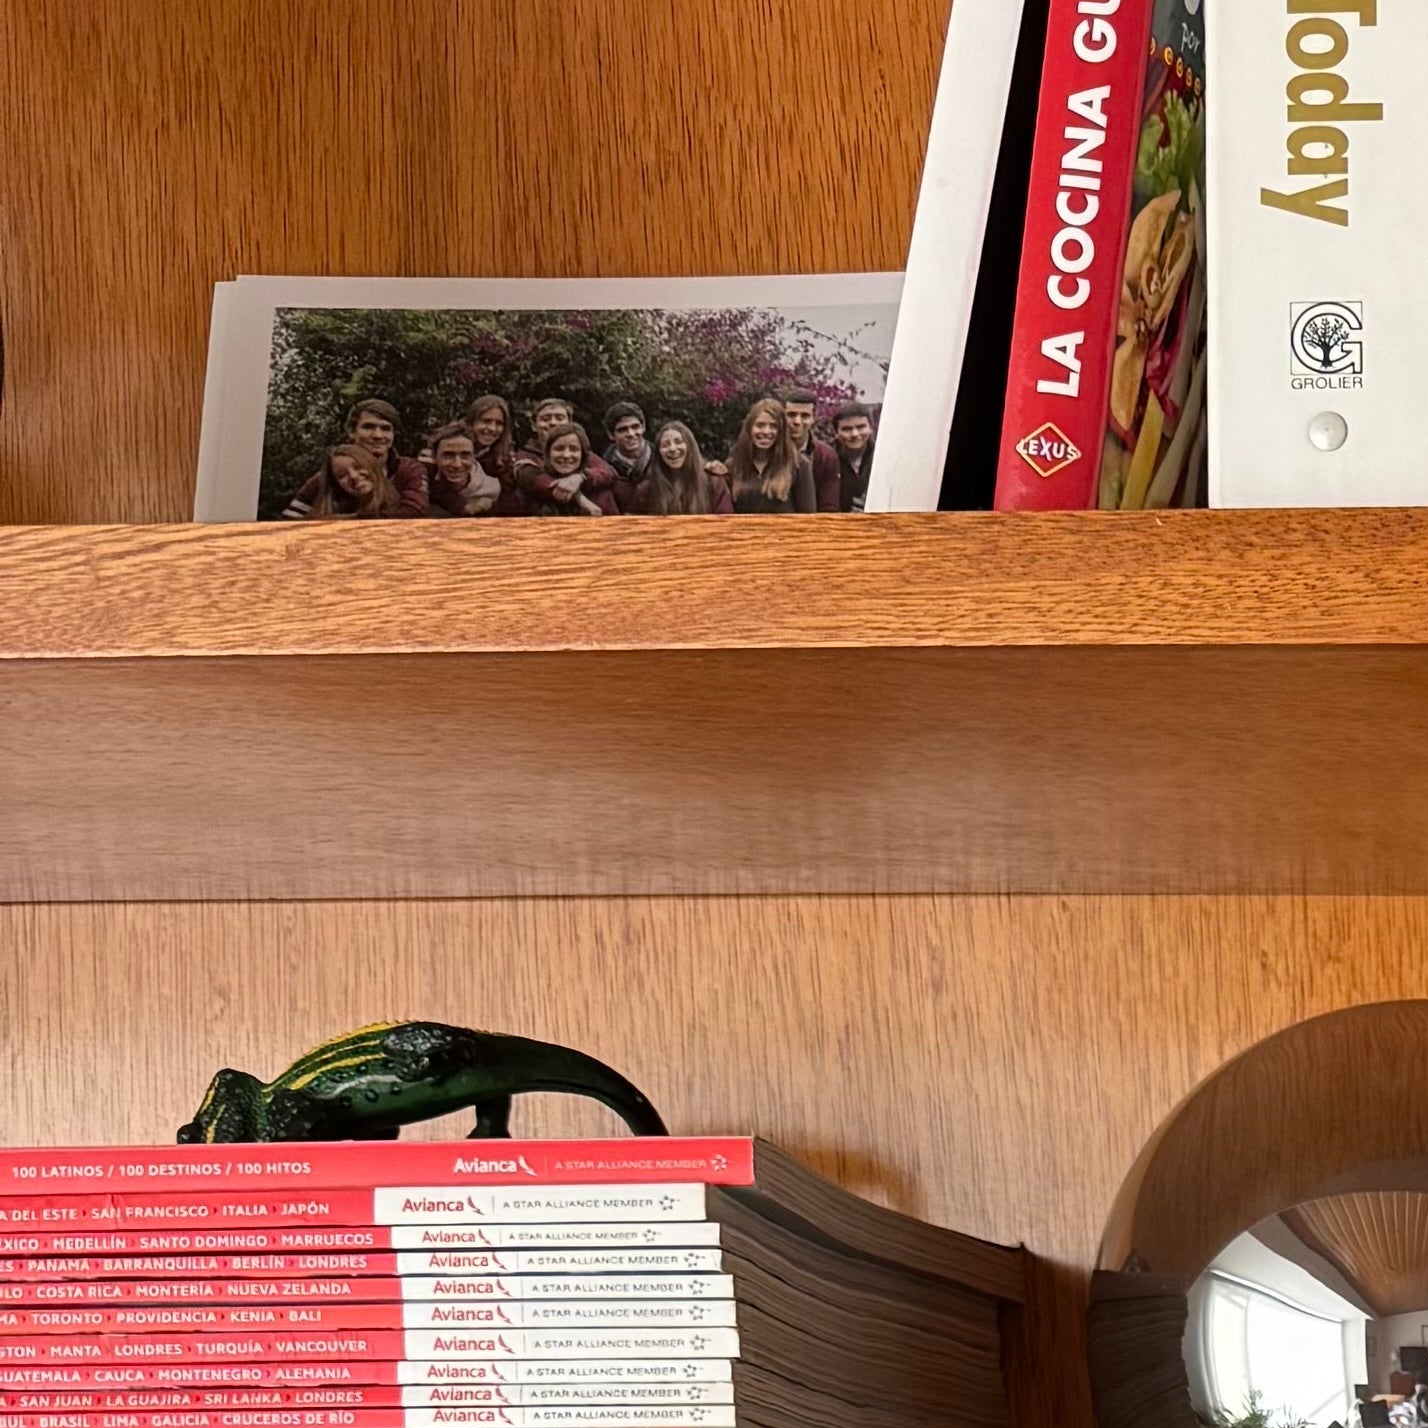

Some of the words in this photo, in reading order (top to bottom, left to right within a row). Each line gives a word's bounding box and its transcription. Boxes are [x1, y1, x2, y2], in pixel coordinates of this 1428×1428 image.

[1048, 84, 1111, 309] COCINA
[1037, 331, 1084, 397] LA
[1291, 376, 1365, 390] GROLIER
[1017, 438, 1081, 462] LEXUS
[11, 1165, 38, 1180] 100
[41, 1164, 104, 1179] LATINOS
[119, 1164, 145, 1178] 100
[148, 1163, 222, 1178] DESTINOS
[236, 1162, 263, 1176] 100
[266, 1161, 312, 1176] HITOS
[453, 1156, 518, 1175] Avianca
[125, 1204, 209, 1219] FRANCISCO
[281, 1200, 330, 1217] JAPÓN
[281, 1232, 374, 1248] MARRUECOS
